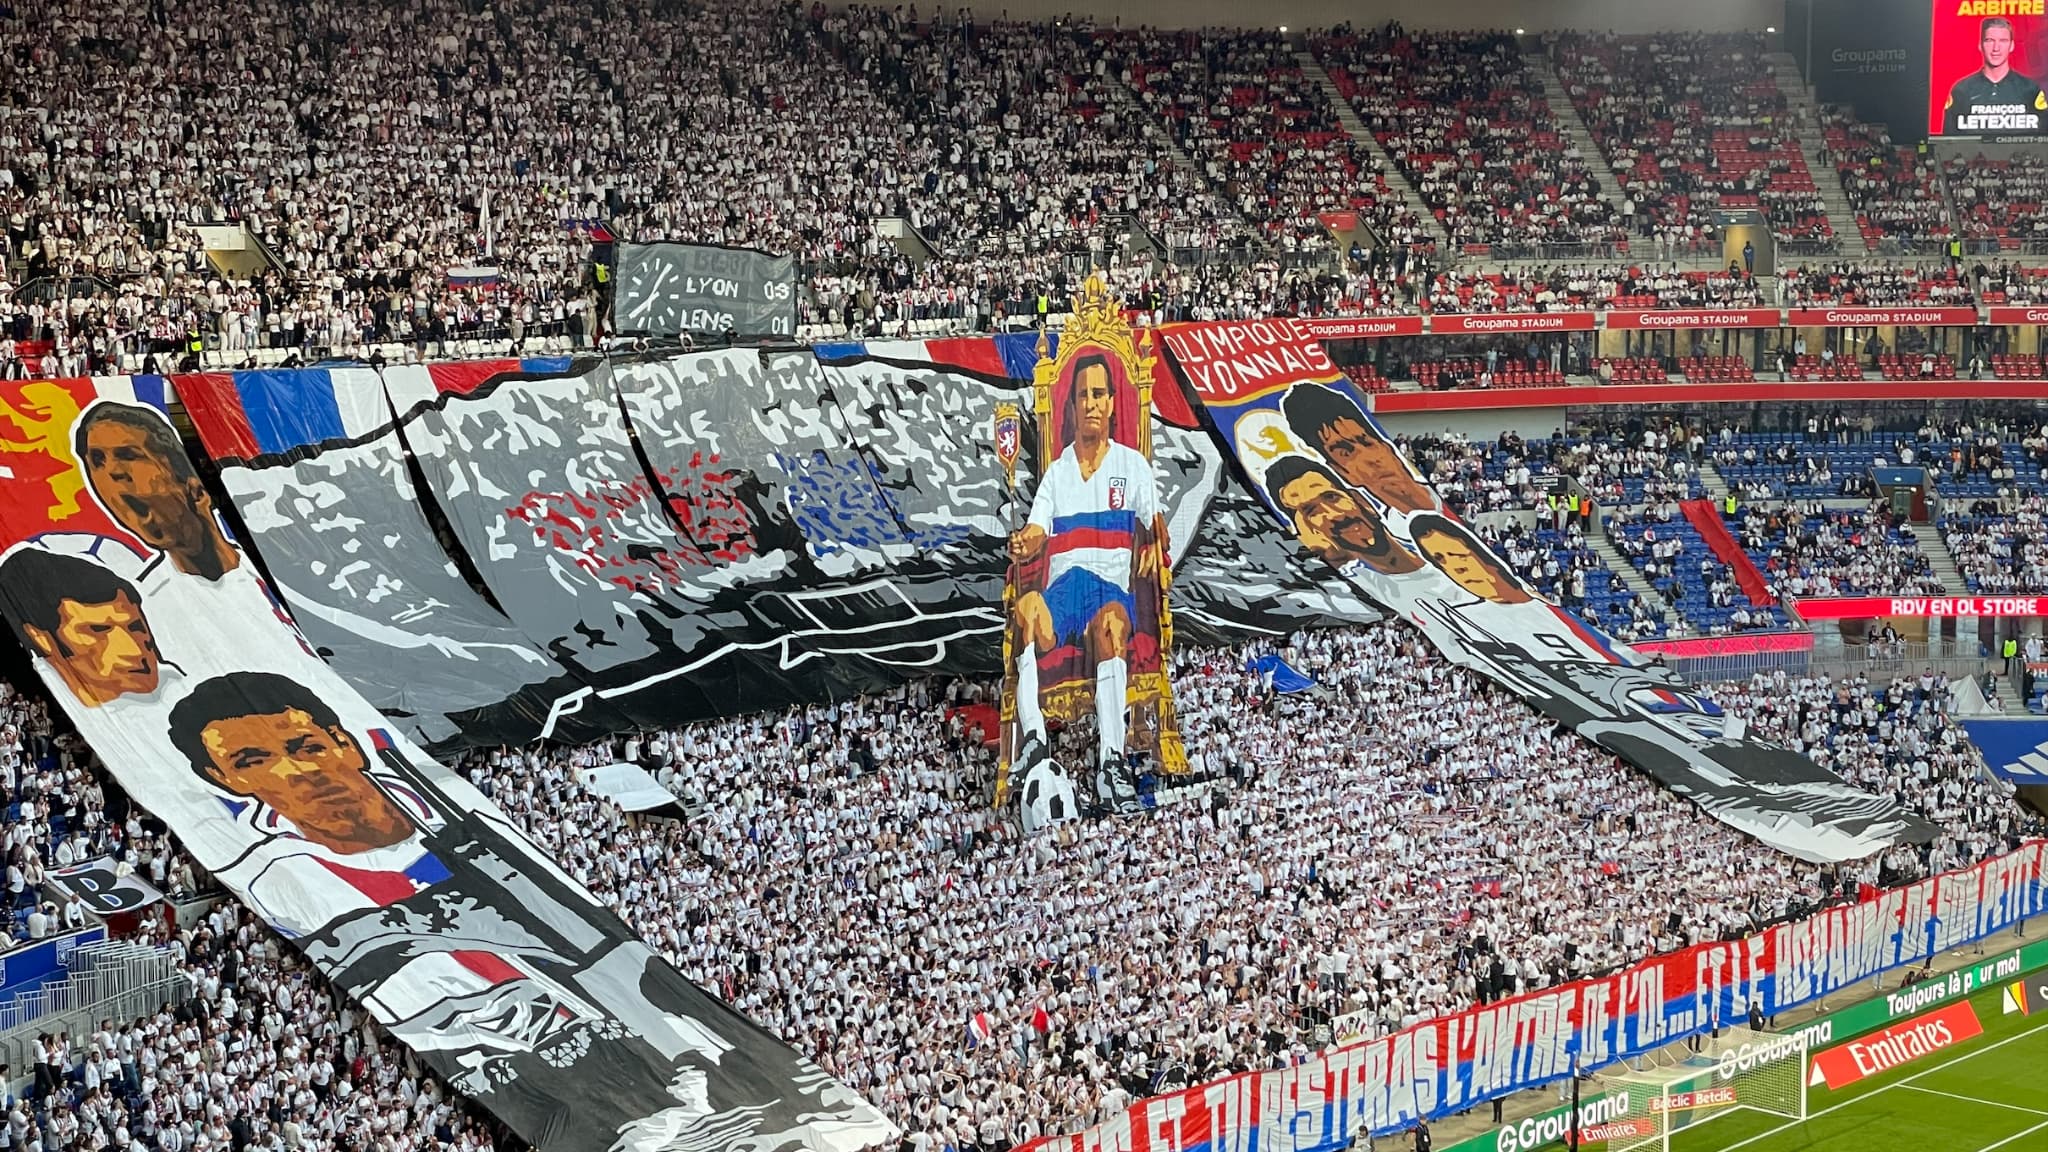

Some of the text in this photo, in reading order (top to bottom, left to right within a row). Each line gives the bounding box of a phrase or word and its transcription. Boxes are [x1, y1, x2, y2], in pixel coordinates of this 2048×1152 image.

[1957, 0, 2045, 16] ARBITRE
[1831, 48, 1906, 64] Groupama
[1858, 64, 1906, 73] STADIUM
[1971, 104, 2026, 115] FRANÇOIS
[1957, 114, 2039, 129] LETEXIER
[685, 276, 739, 298] LYON
[680, 308, 789, 335] LENS 01
[1463, 317, 1563, 330] Groupama STADIUM
[1639, 314, 1748, 326] Groupama STADIUM
[1826, 311, 1942, 323] Groupama STADIUM
[1358, 323, 1396, 333] STADIUM
[1164, 317, 1312, 363] OLYMPIQUE
[1181, 343, 1331, 395] LYONNAIS
[1891, 599, 2038, 615] RDV EN OL STORE
[1887, 980, 1946, 1017] Toujours
[1949, 971, 1961, 995] là
[1997, 949, 2021, 977] moi
[1204, 1075, 1251, 1152] TU
[1259, 1026, 1438, 1152] RESTERAS
[1447, 989, 1576, 1106] L'ANTRE
[1580, 981, 1610, 1066] DE
[1696, 947, 1727, 1027] ET
[1731, 934, 1765, 1017] LE
[1774, 889, 1906, 1008] ROYAUME
[1900, 878, 1934, 959] DE
[1934, 867, 1982, 953] SON
[1980, 844, 2038, 936] PETIT
[1848, 1019, 1953, 1076] Emirates
[1696, 1090, 1733, 1105] Betclic
[1584, 1123, 1637, 1143] Emirates
